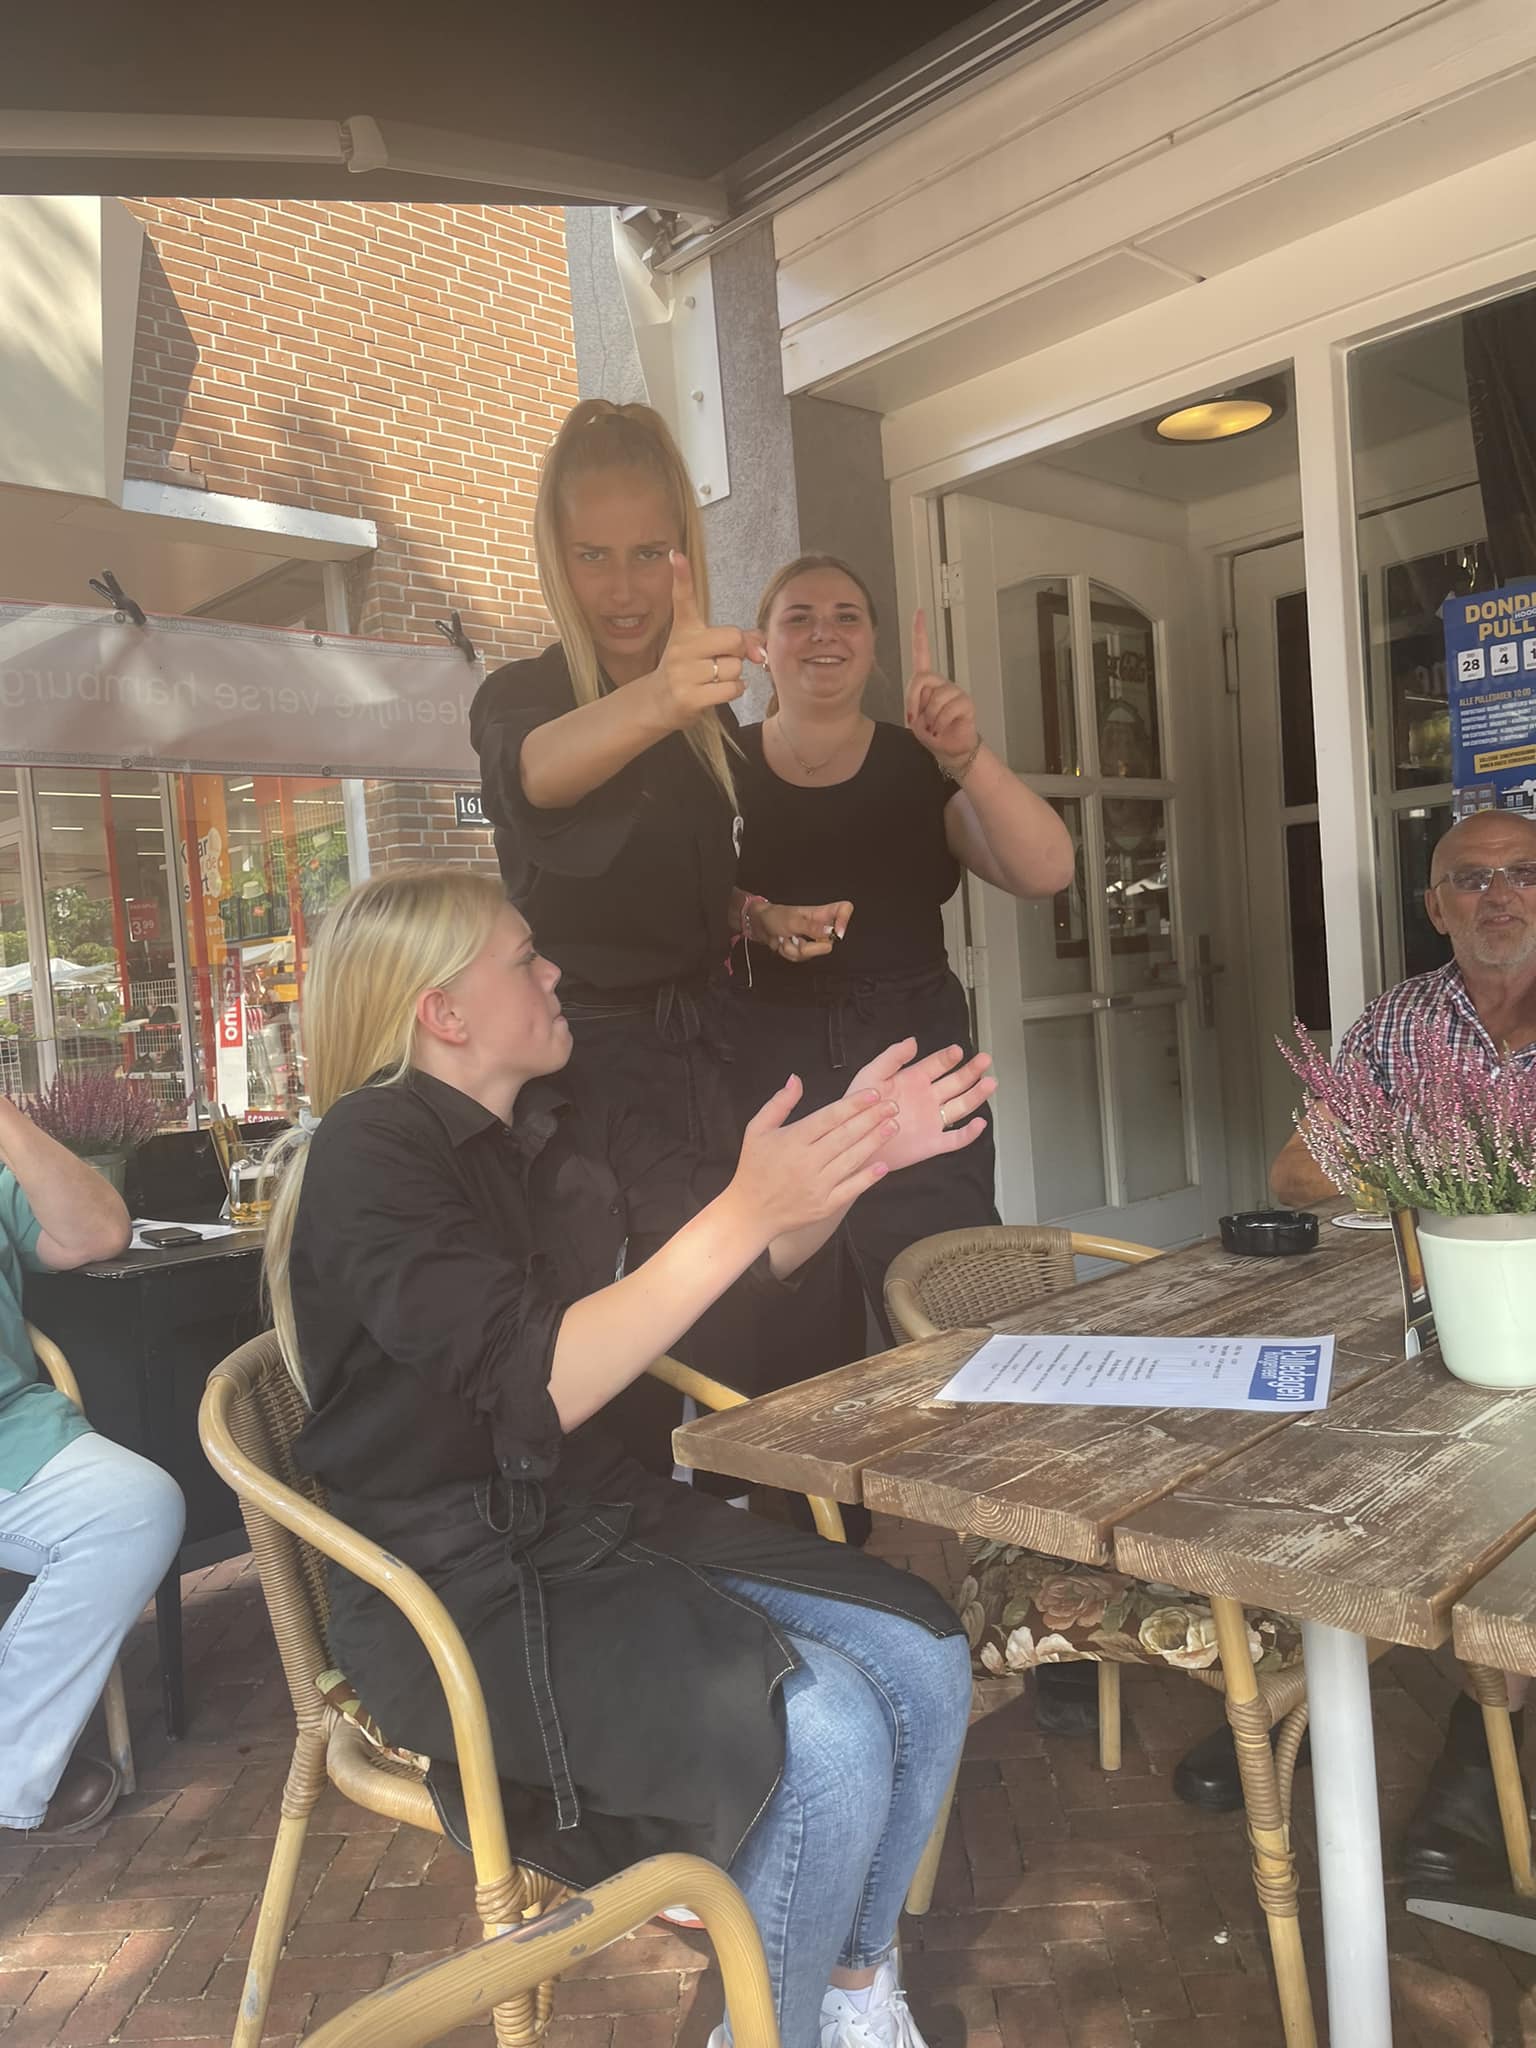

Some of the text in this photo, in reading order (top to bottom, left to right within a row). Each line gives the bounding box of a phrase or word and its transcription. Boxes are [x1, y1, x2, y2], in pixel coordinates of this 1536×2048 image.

[1463, 659, 1480, 672] 28
[1499, 653, 1509, 665] 4
[460, 797, 482, 814] 161
[1268, 1348, 1317, 1401] Pulledagen
